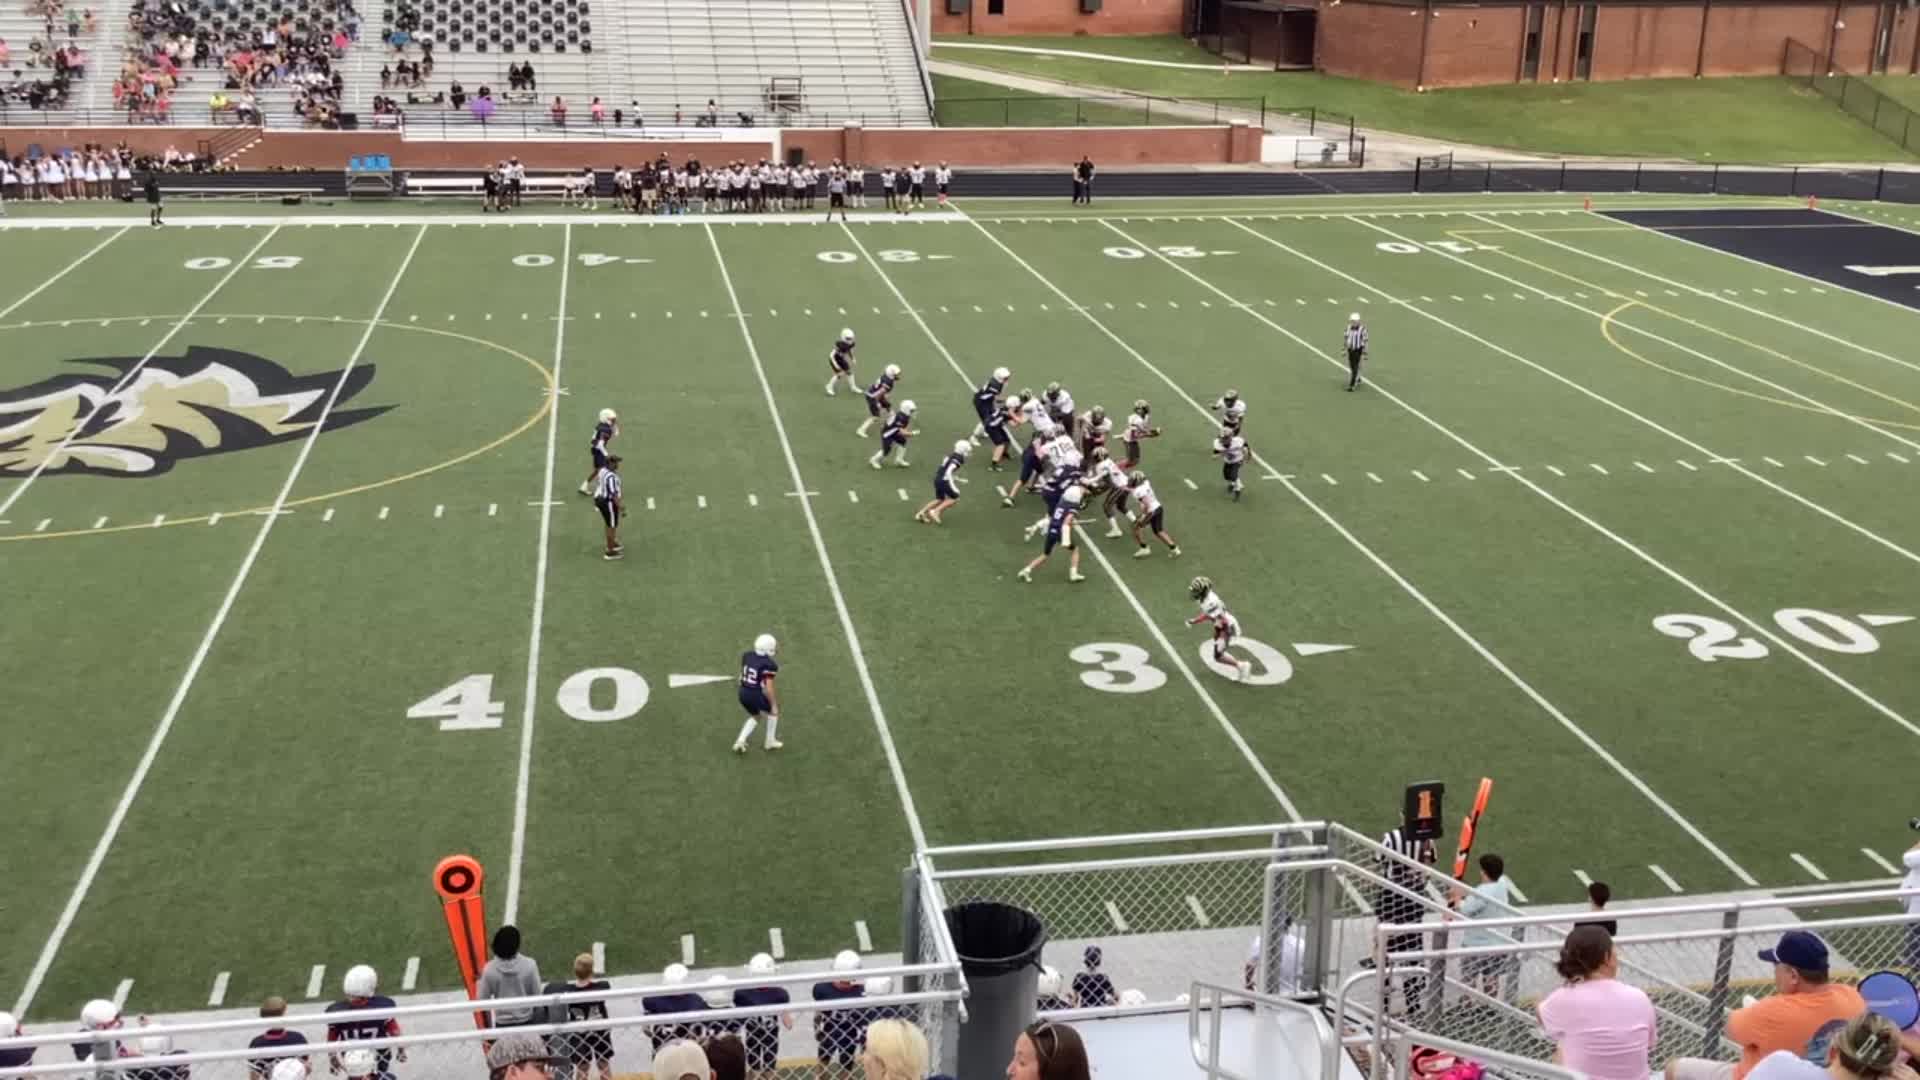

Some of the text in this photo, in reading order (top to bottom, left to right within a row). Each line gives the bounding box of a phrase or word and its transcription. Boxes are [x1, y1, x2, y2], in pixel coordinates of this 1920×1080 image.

[1652, 608, 1880, 662] 20
[1069, 634, 1293, 693] 30
[406, 666, 650, 730] 40
[1417, 789, 1433, 819] 1
